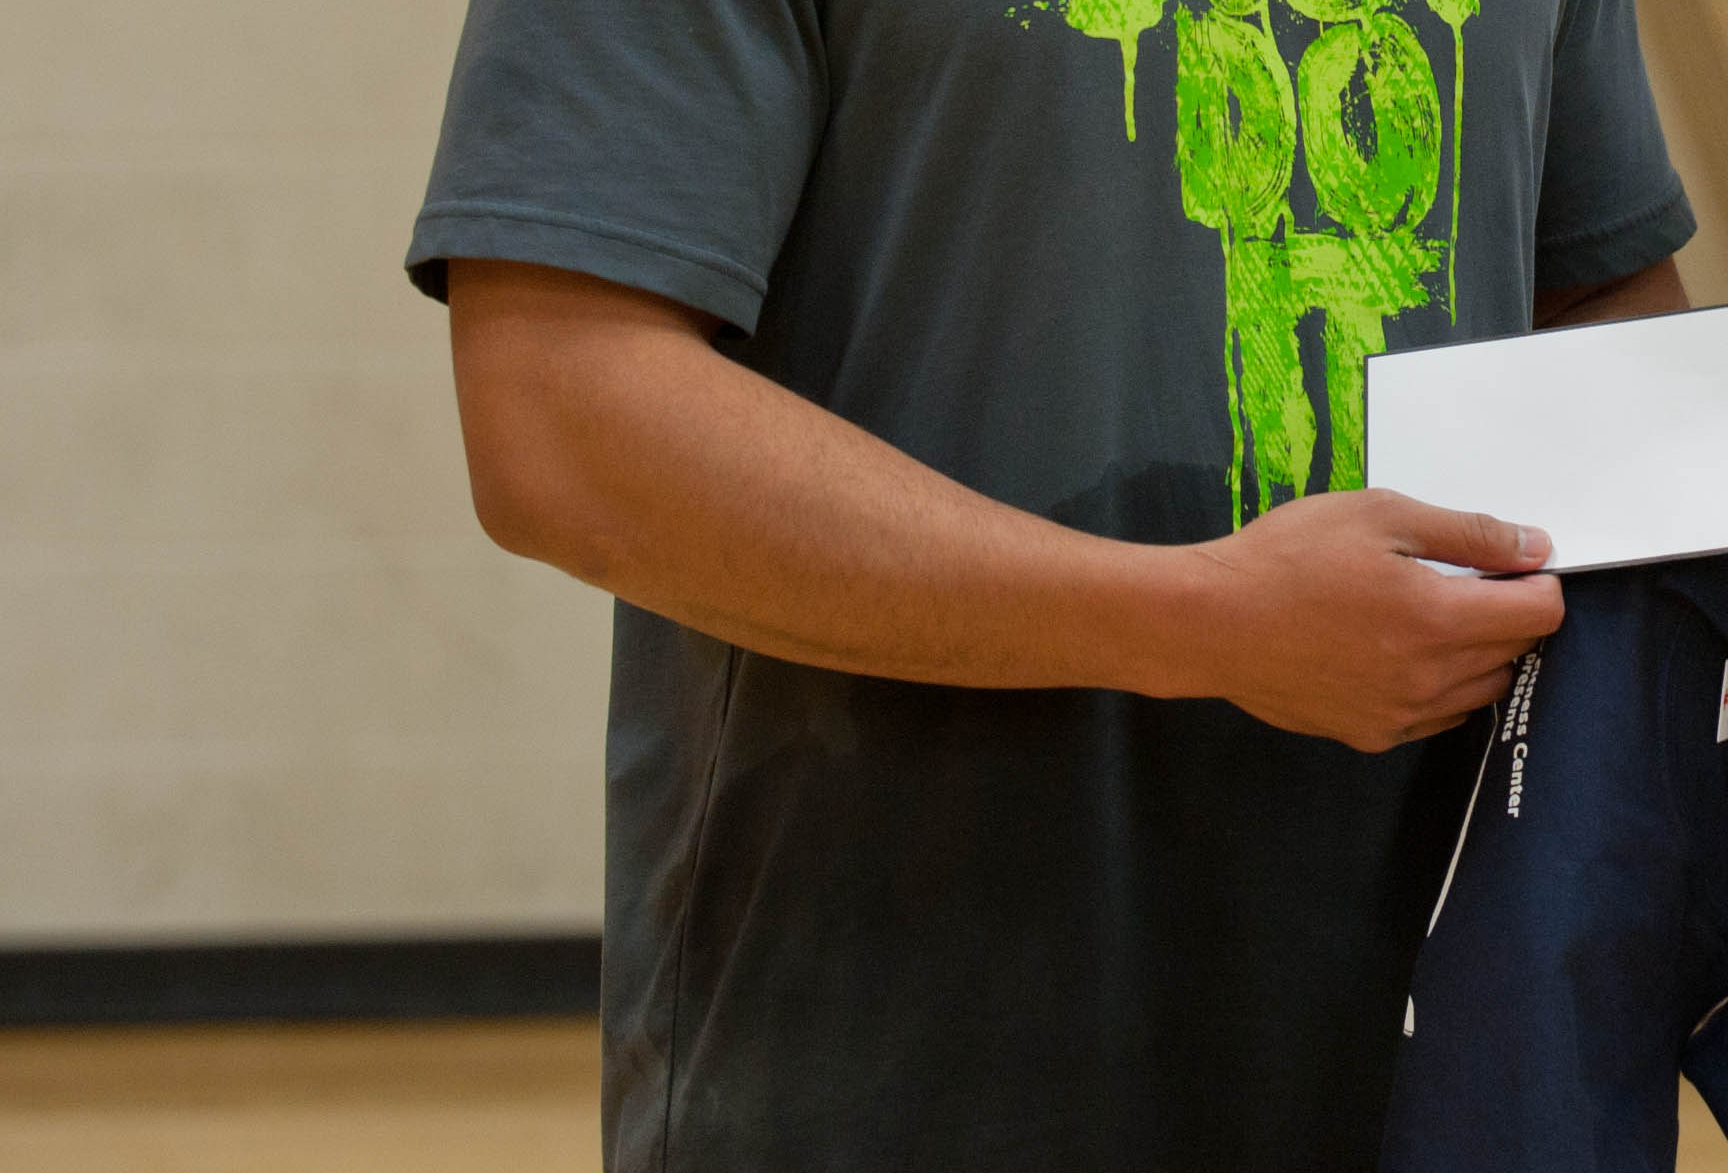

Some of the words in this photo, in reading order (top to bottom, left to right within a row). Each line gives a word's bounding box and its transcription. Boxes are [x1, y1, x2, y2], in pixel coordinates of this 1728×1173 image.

[1174, 4, 1443, 240] DO
[1226, 228, 1448, 518] IT
[1507, 742, 1529, 818] Center
